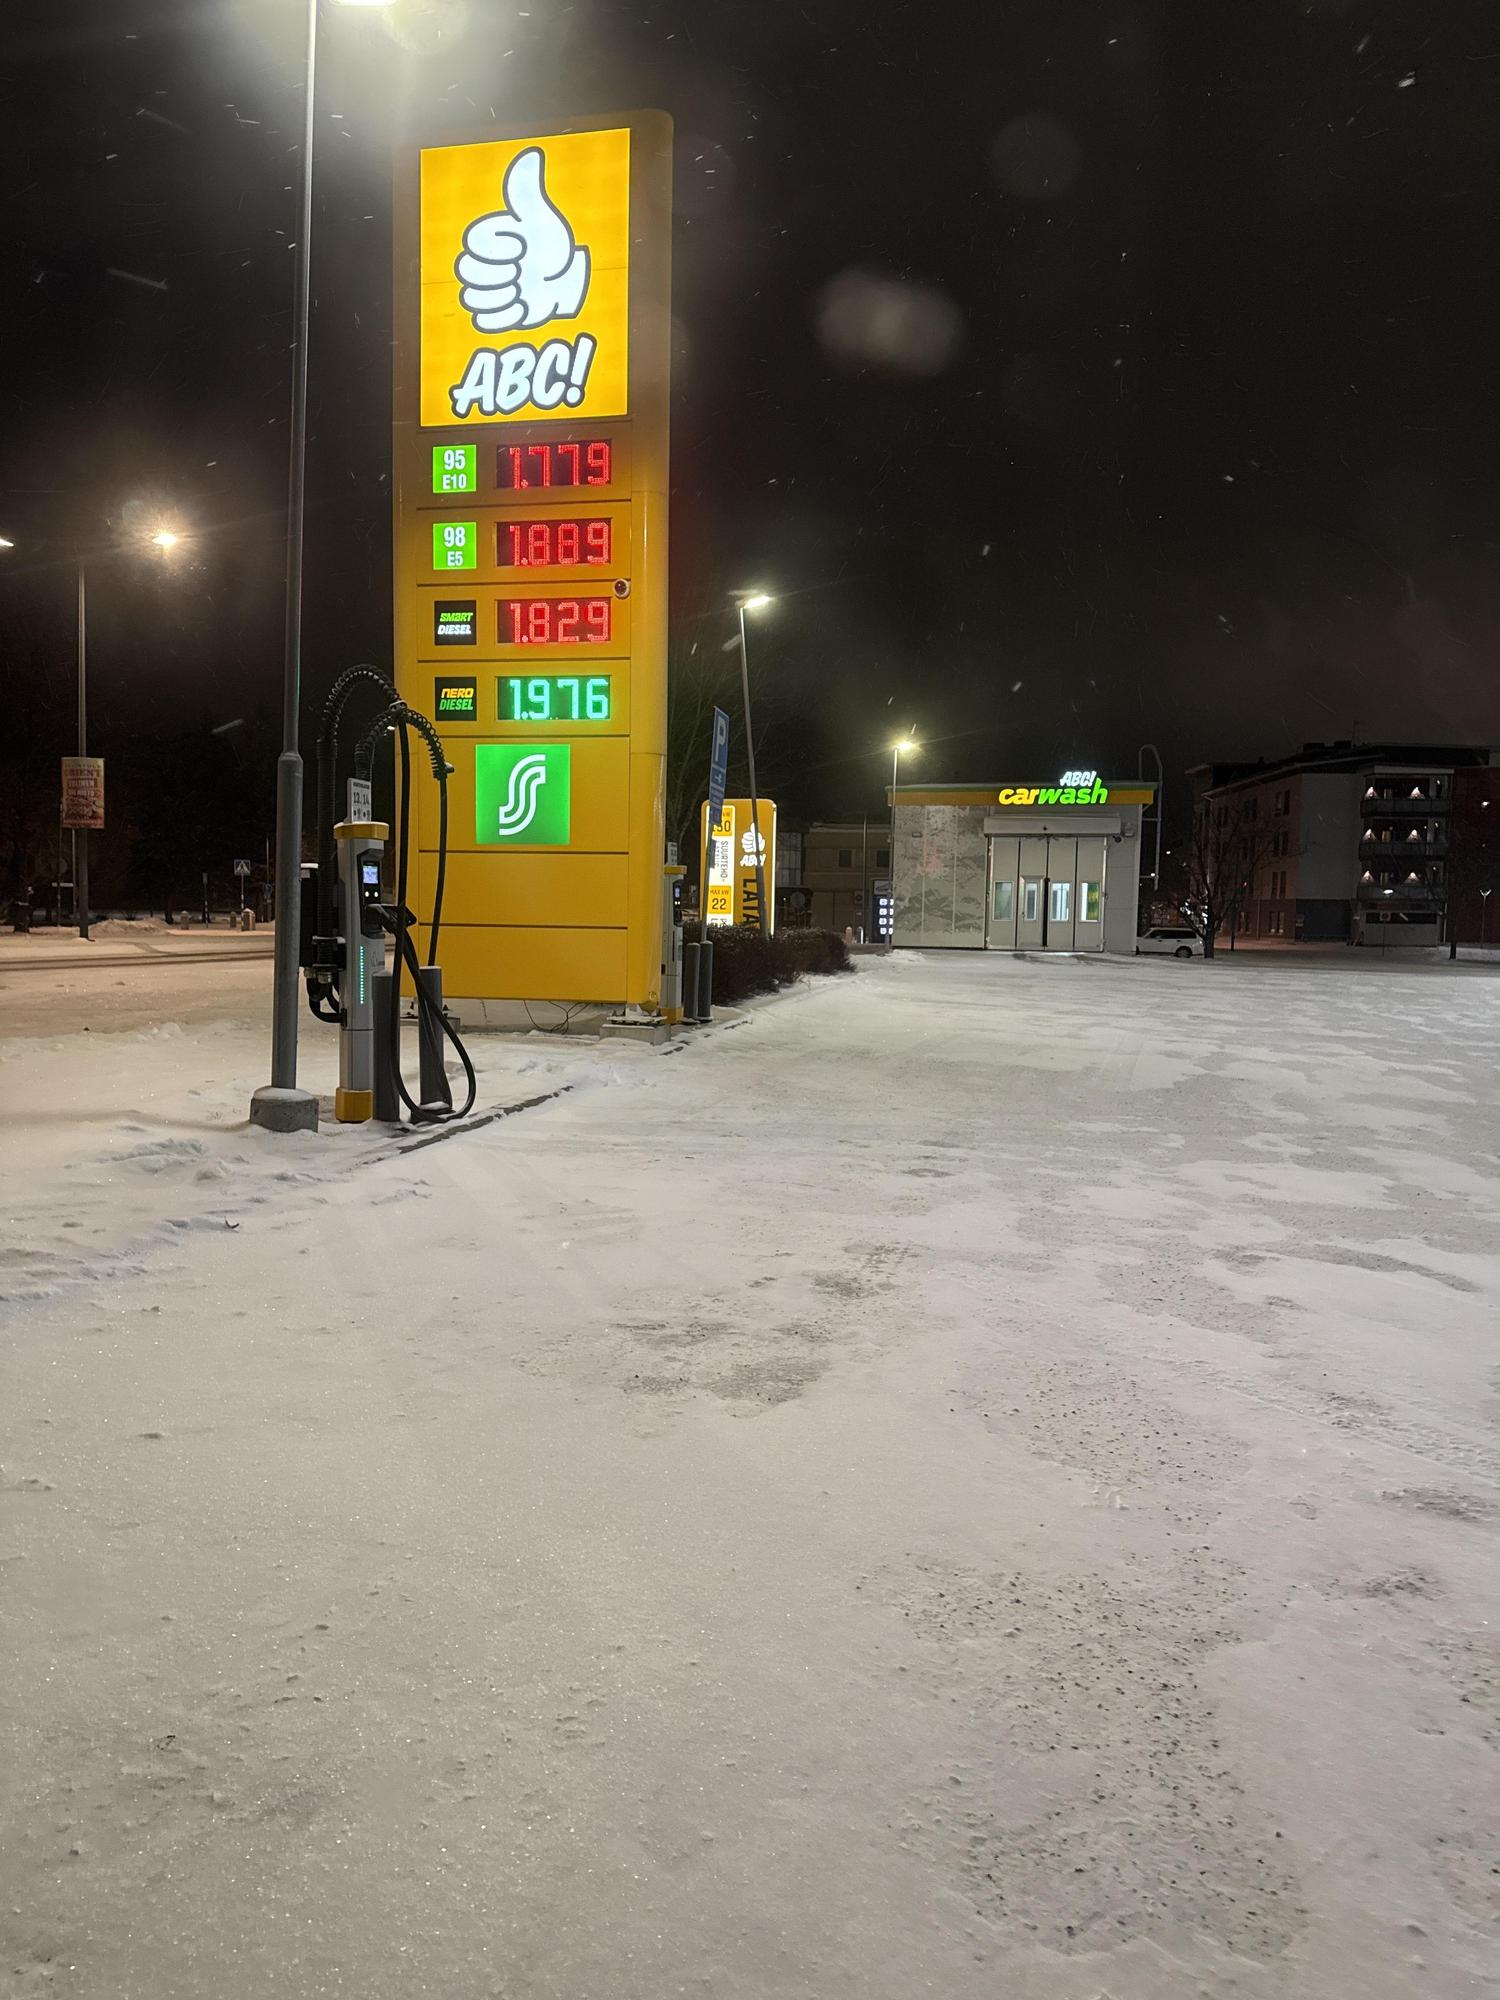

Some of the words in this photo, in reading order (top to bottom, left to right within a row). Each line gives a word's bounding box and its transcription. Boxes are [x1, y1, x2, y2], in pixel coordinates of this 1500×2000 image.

[449, 333, 597, 418] ABC!
[443, 449, 466, 470] 95
[509, 443, 609, 489] 1.779
[442, 474, 467, 489] E10
[443, 526, 466, 547] 98
[509, 522, 609, 566] 1.889
[447, 551, 464, 566] E5
[437, 624, 472, 635] DIESEL
[510, 601, 609, 643] 1.829
[439, 698, 474, 711] DIESEL
[509, 678, 609, 720] 1.976
[715, 717, 726, 762] P
[1059, 770, 1097, 787] ABC!
[998, 777, 1109, 805] carwash
[712, 898, 727, 910] 22
